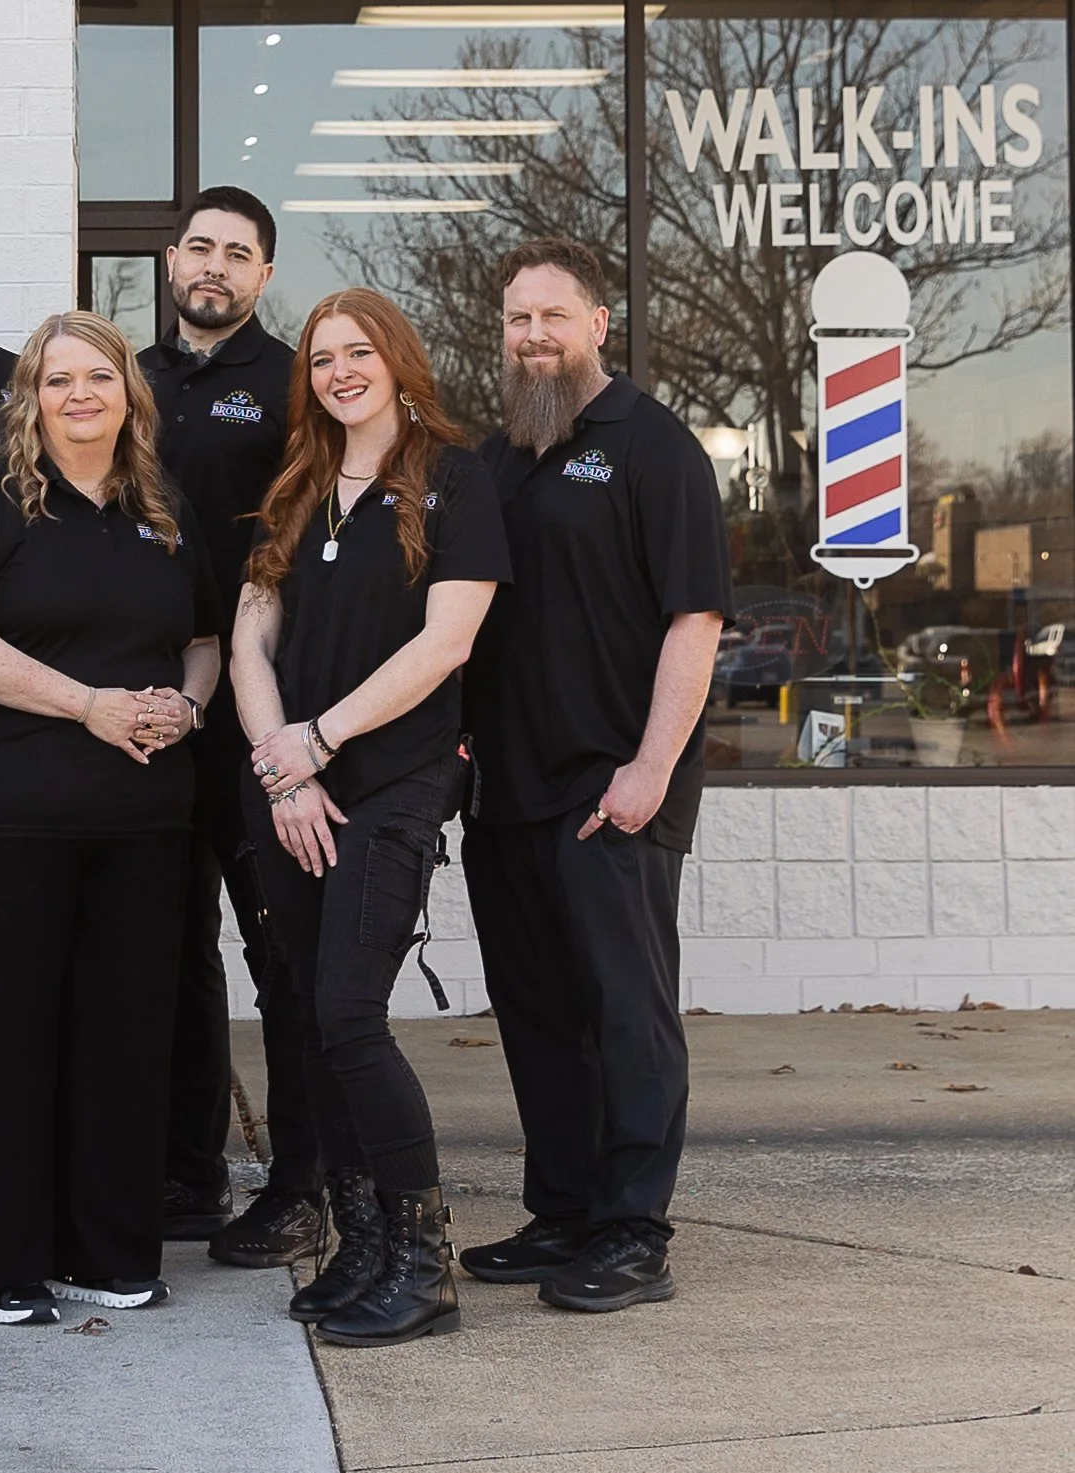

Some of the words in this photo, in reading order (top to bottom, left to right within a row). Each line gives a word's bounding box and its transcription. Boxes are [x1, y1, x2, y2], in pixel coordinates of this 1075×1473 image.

[664, 82, 1042, 173] WALK-INS
[712, 178, 1016, 248] WELCOME
[211, 404, 262, 421] BROVADO
[564, 463, 611, 480] BROVADO
